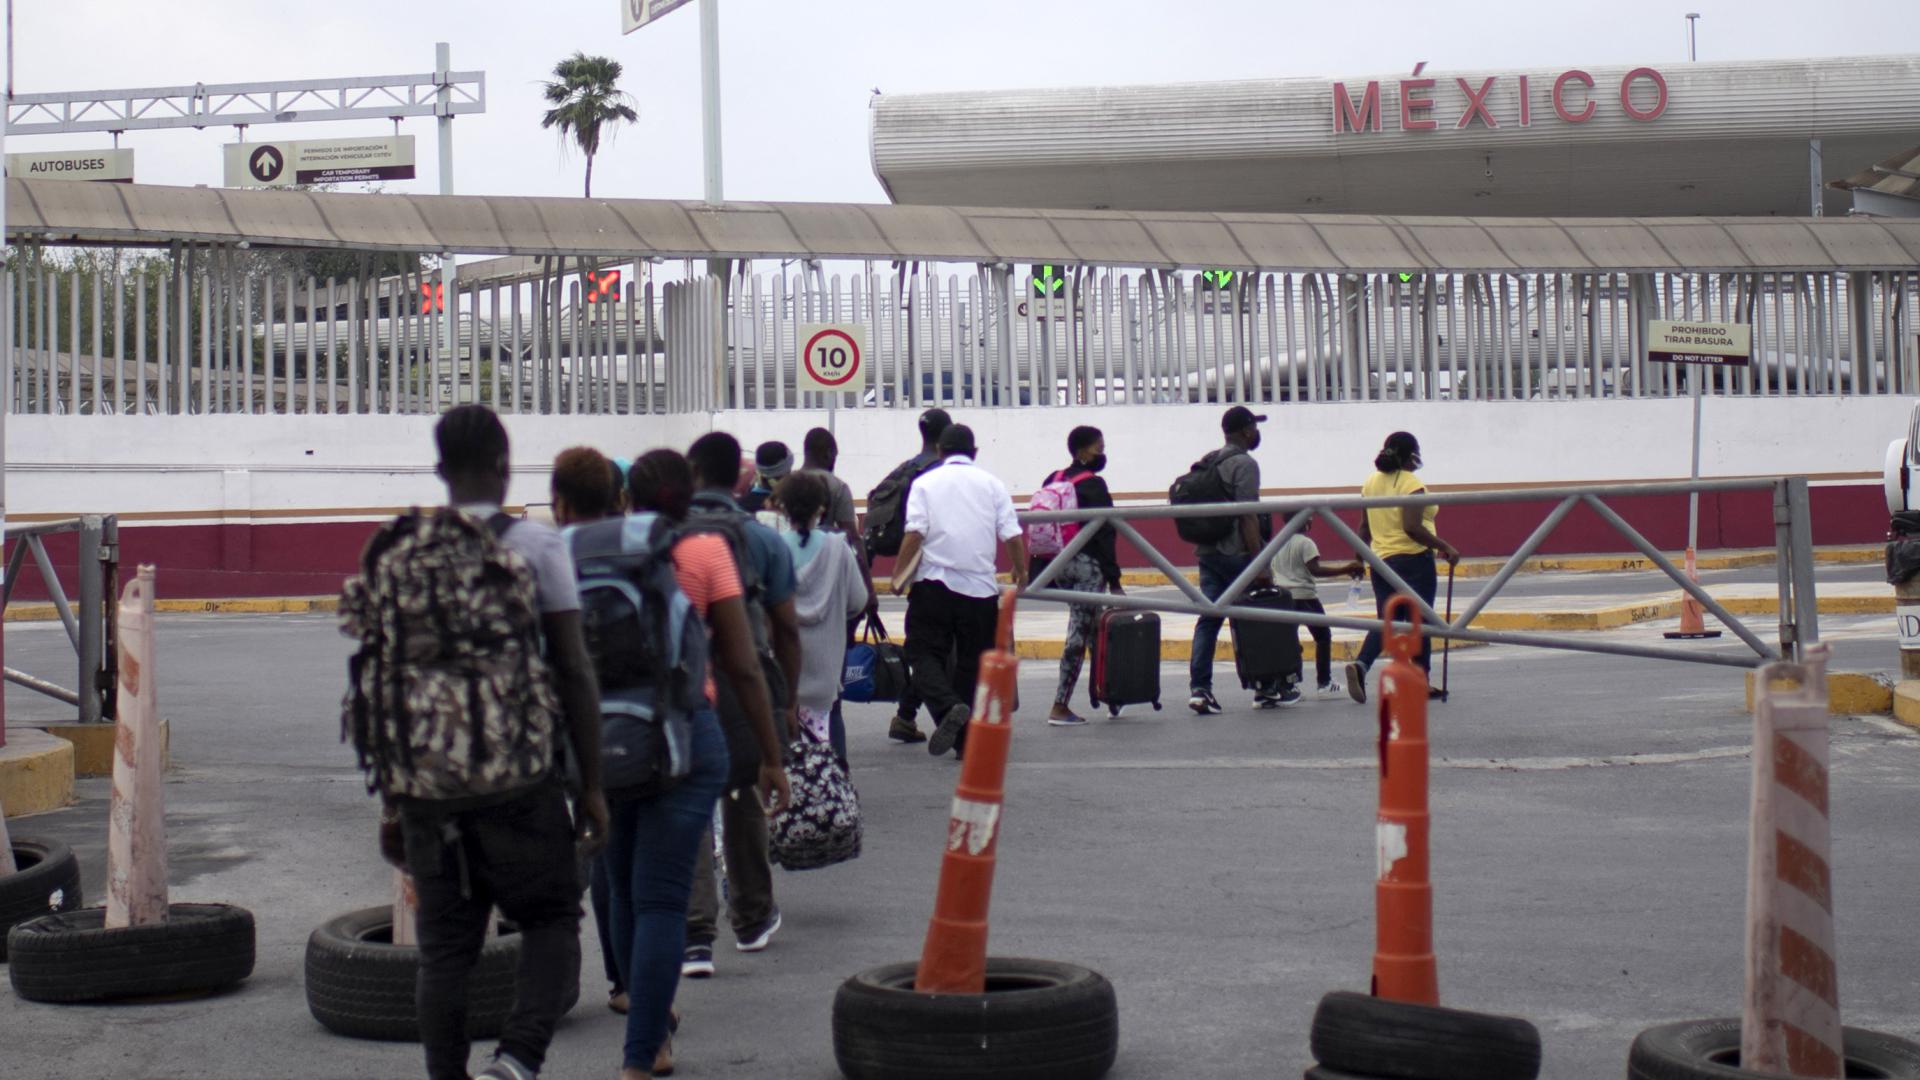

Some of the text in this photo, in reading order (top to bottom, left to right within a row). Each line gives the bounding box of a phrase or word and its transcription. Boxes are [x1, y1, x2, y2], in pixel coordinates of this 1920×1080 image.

[1333, 61, 1669, 134] MÉXICO
[30, 158, 105, 172] AUTOBUSES
[1672, 326, 1726, 335] PROHIBIDO
[1664, 335, 1733, 346] TIRAR BASURA
[817, 347, 846, 368] 10
